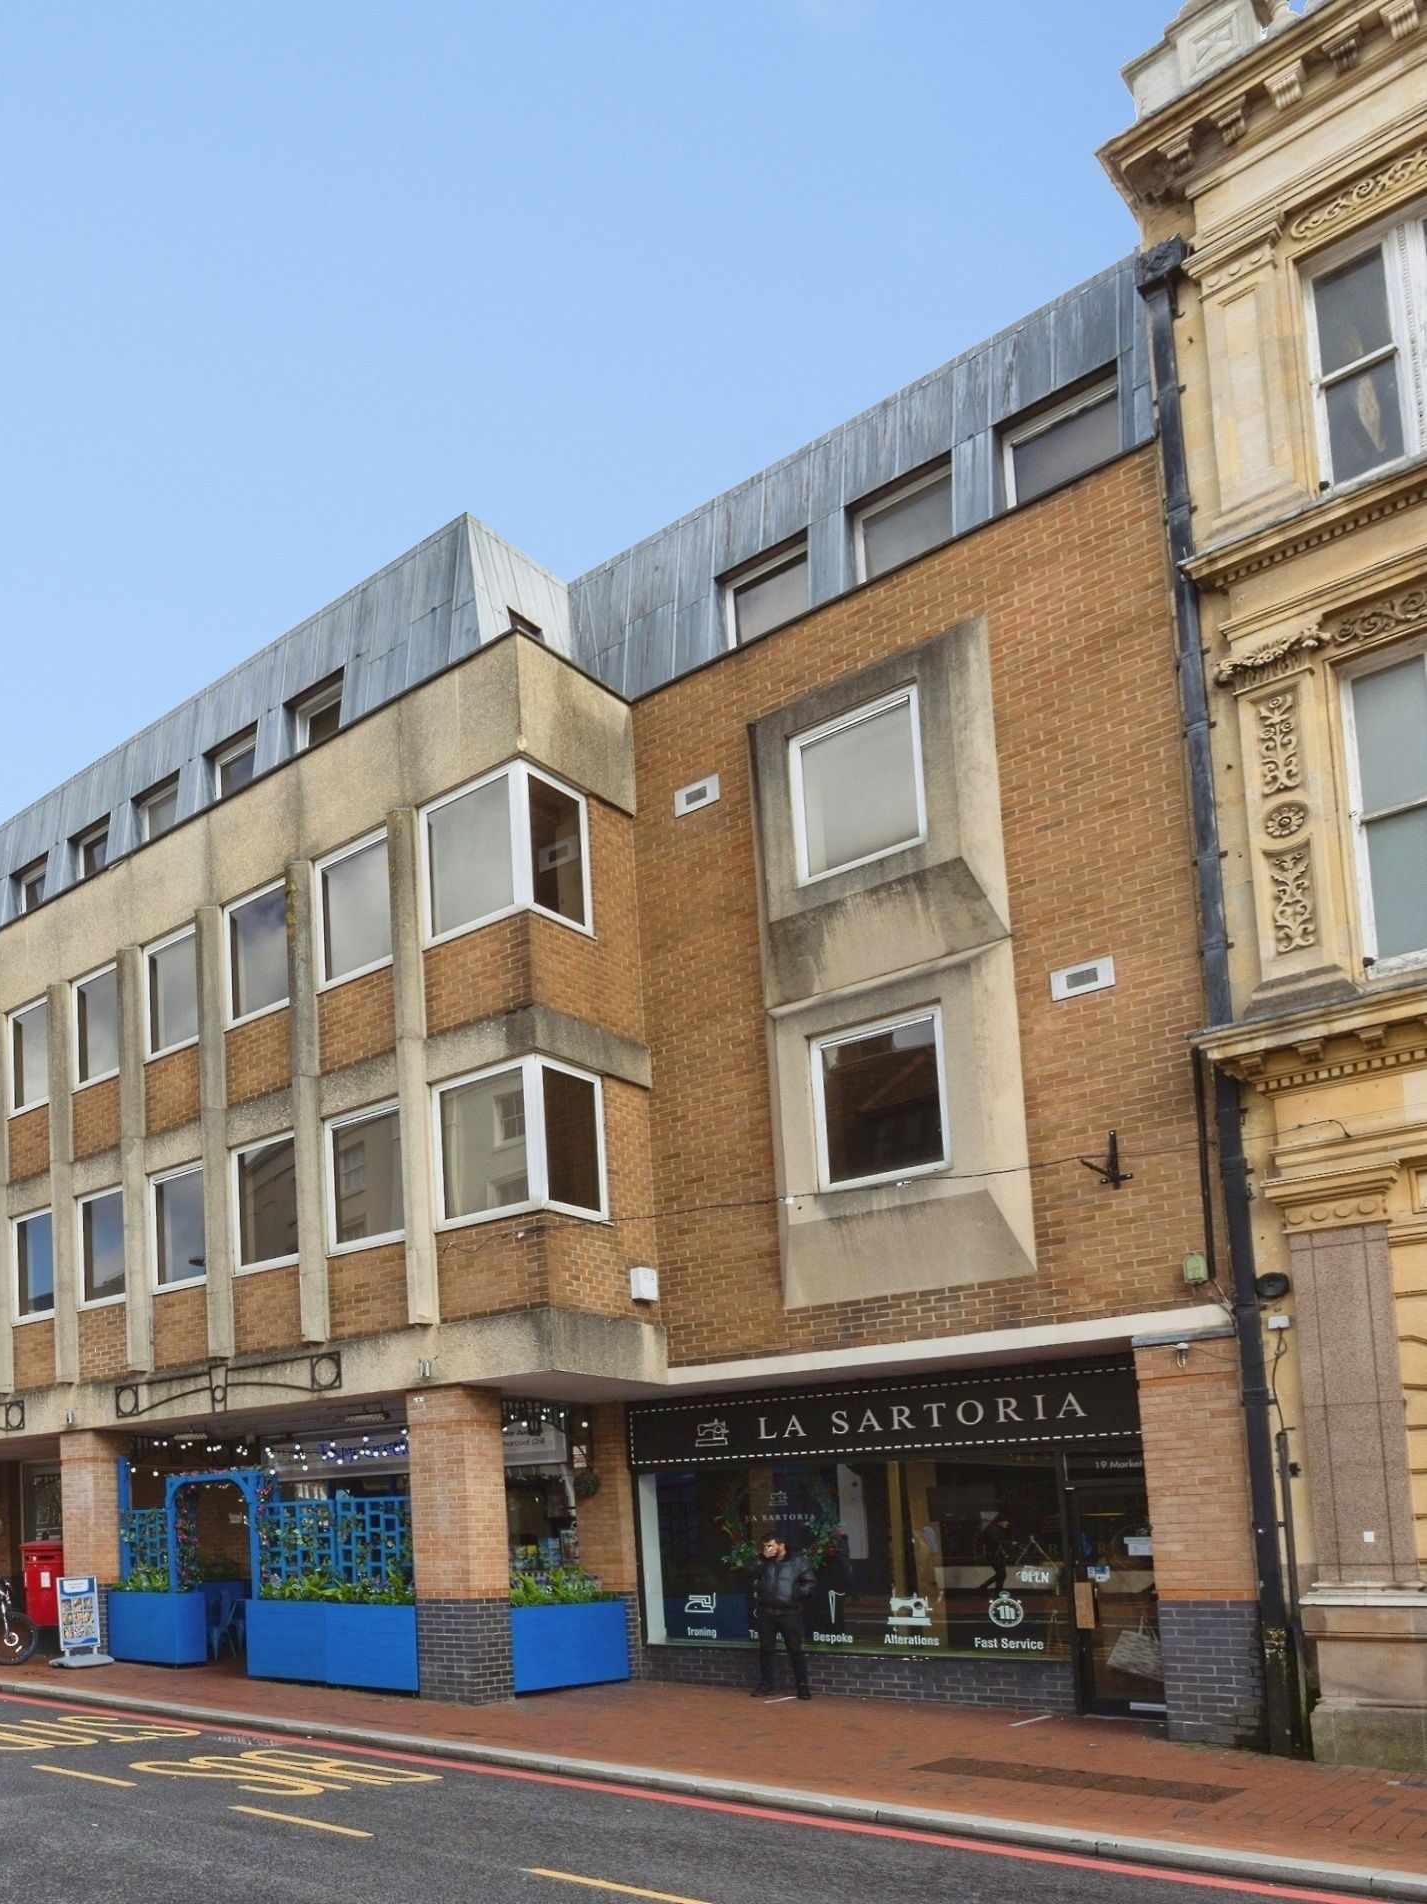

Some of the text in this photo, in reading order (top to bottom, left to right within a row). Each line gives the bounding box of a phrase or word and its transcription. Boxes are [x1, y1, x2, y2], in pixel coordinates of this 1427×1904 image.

[757, 1391, 1088, 1440] LA SARTORIA
[1095, 1460, 1108, 1469] 19
[1021, 1571, 1050, 1583] OPEN
[997, 1606, 1015, 1620] 1h
[687, 1626, 717, 1639] Ironing
[813, 1631, 853, 1644] Bespoke
[884, 1633, 940, 1646] Alterations
[974, 1637, 1044, 1650] Fast Service
